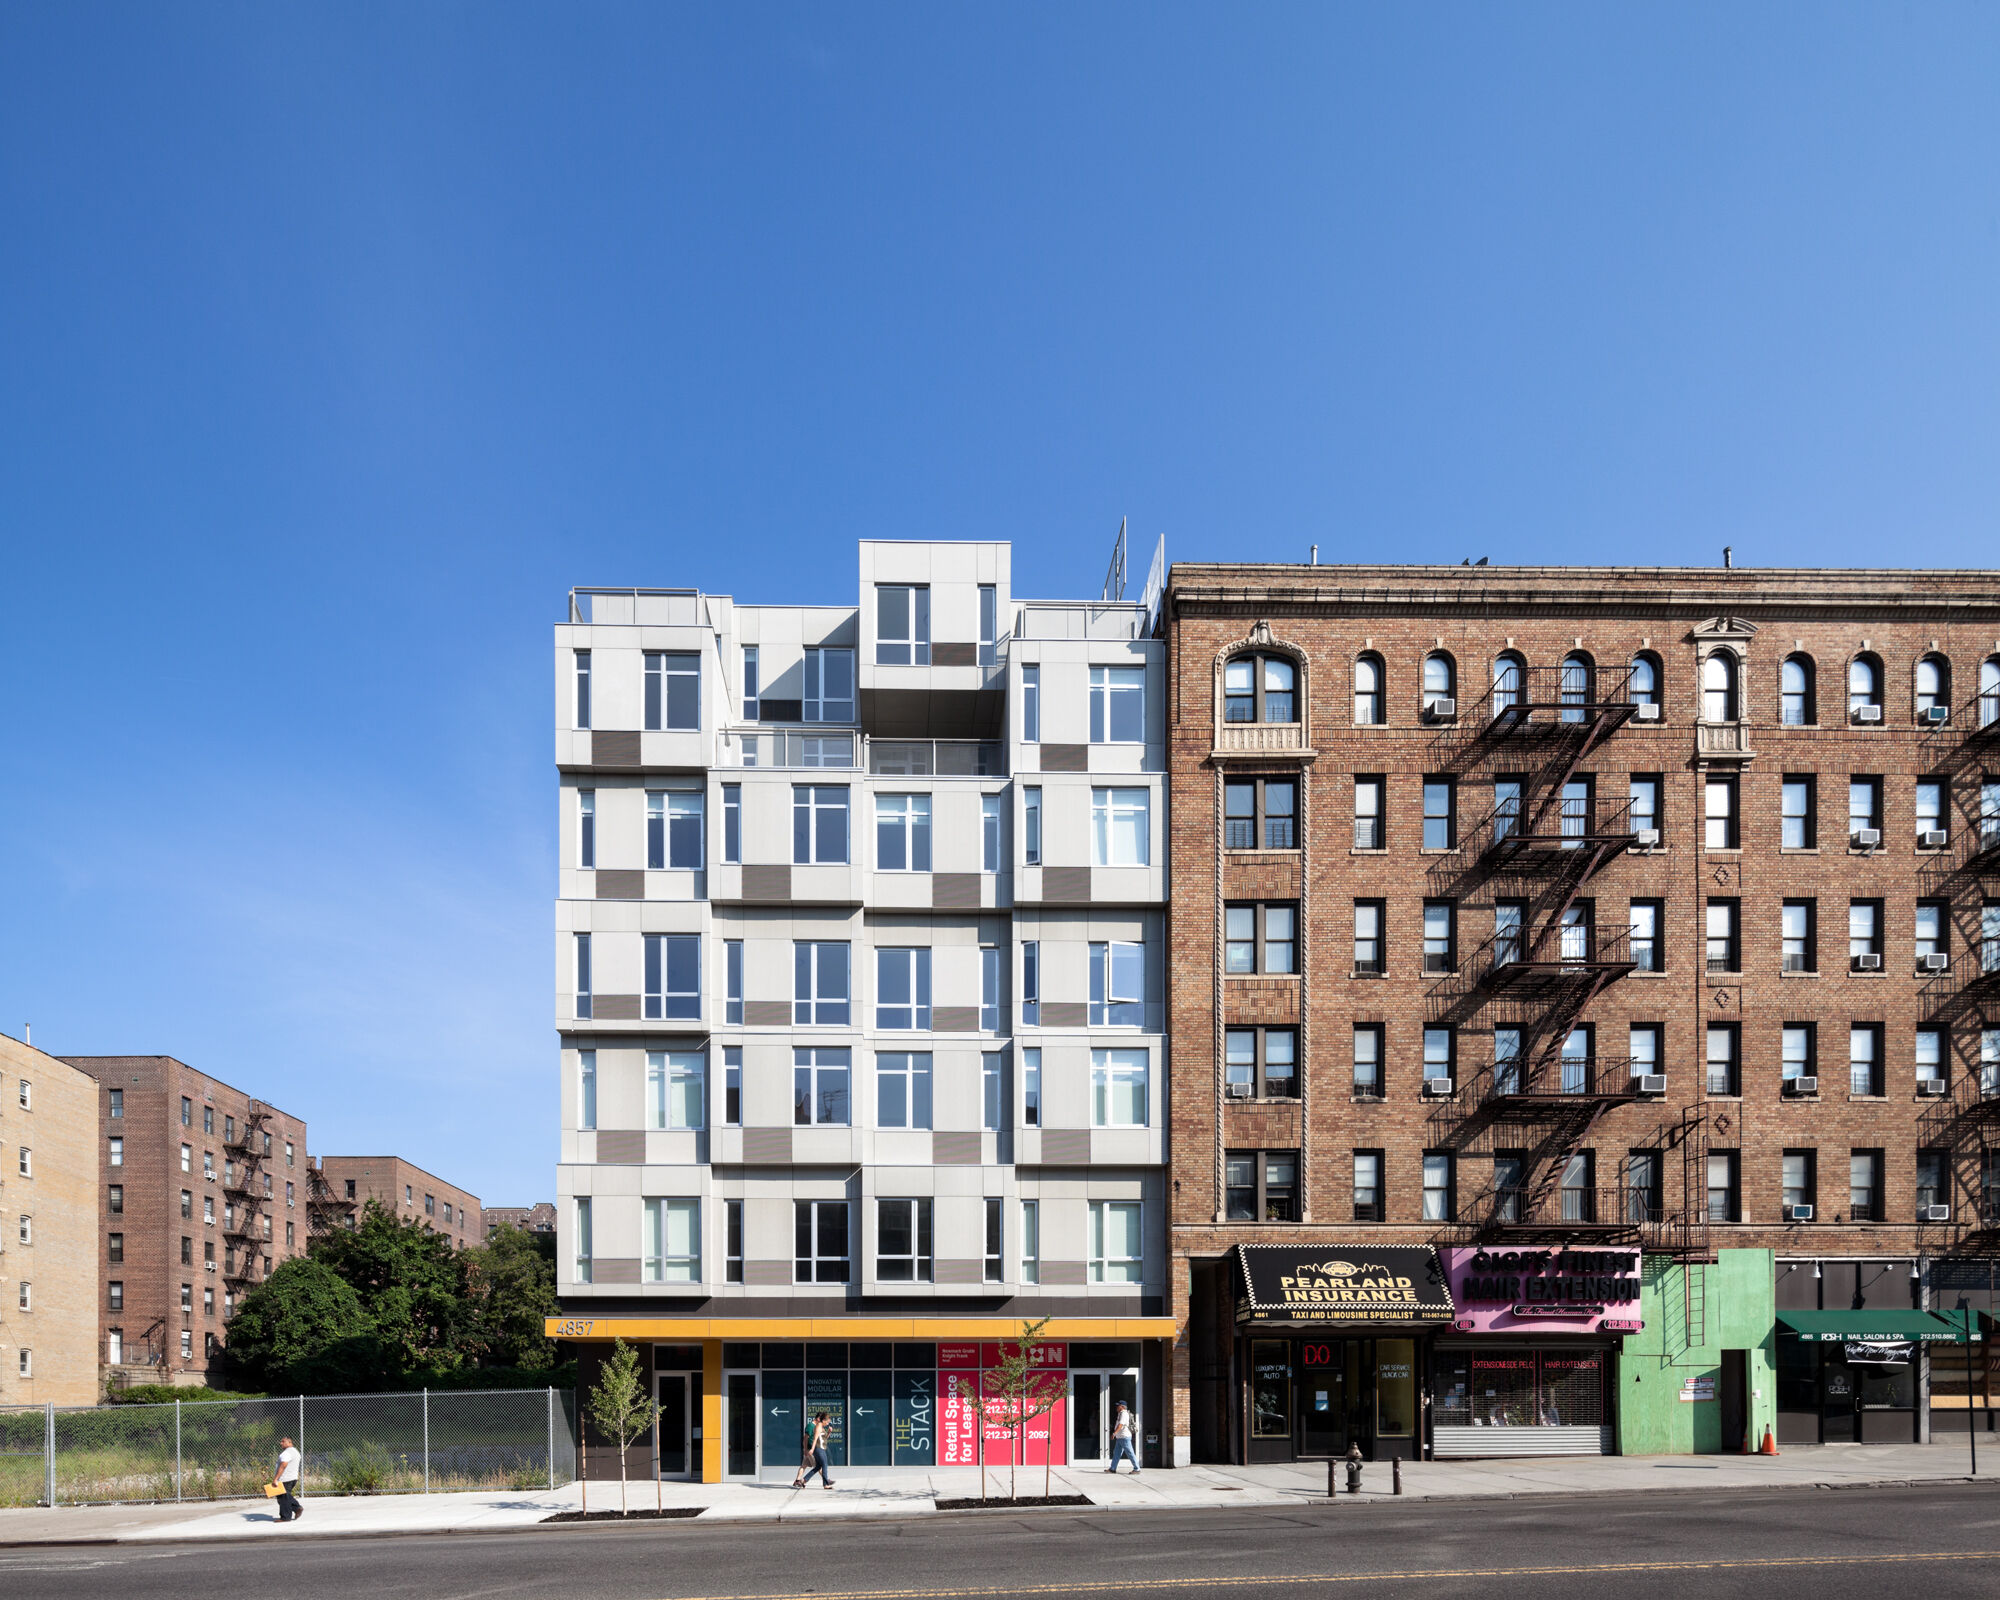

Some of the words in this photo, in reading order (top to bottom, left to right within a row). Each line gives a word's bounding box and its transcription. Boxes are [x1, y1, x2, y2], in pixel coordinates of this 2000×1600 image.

[1559, 1251, 1640, 1272] FINEST
[1281, 1276, 1412, 1288] PEARLAND
[1462, 1276, 1521, 1301] HAIR
[1526, 1276, 1641, 1301] EXTENSION
[1284, 1290, 1418, 1302] INSURANCE
[1291, 1311, 1309, 1319] TAXI
[1310, 1311, 1326, 1319] AND
[1326, 1311, 1369, 1319] LIMOUSINE
[1370, 1311, 1414, 1320] SPECIALIST
[556, 1320, 594, 1335] 4857
[945, 1375, 960, 1418] Space
[911, 1379, 929, 1450] STACK
[960, 1397, 972, 1438] Lease
[896, 1418, 910, 1450] THE
[945, 1422, 957, 1462] Retail
[960, 1442, 972, 1462] for
